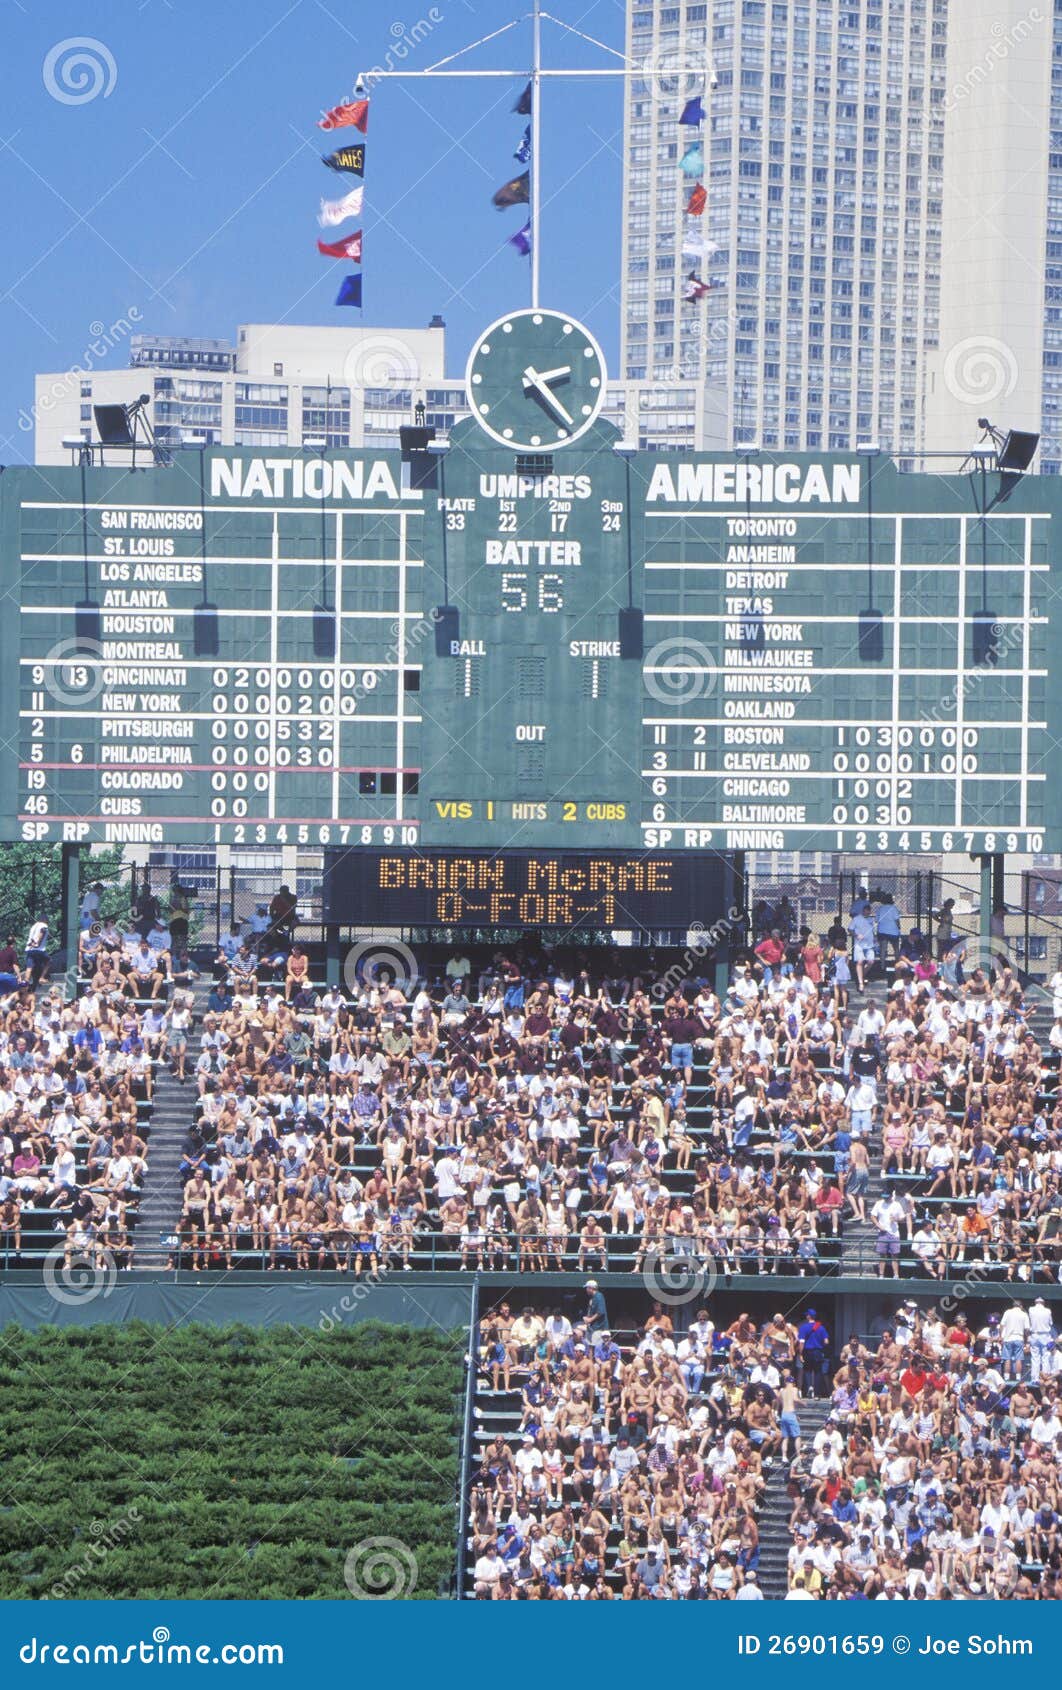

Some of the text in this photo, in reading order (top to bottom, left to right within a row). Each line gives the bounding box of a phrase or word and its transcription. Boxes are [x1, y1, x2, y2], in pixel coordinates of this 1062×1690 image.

[211, 458, 423, 499] NATIONAL
[480, 475, 592, 498] UMPIRES
[645, 464, 860, 503] AMERICAN
[437, 498, 623, 512] PLATE 1ST 2ND 3RD
[101, 512, 202, 530] SAN FRANCISCO
[446, 514, 621, 532] 33 22 17 24
[727, 519, 797, 537] TORONTO
[104, 538, 174, 556] ST. LOUIS
[486, 540, 581, 566] BATTER
[727, 545, 796, 563] ANAHEIM
[101, 564, 202, 582] LOS ANGELES
[725, 572, 789, 589] DETROIT
[103, 590, 168, 608] ATLANTA
[725, 598, 772, 615] TEXAS
[103, 617, 174, 634] HOUSTON
[725, 624, 803, 642] NEW YORK
[103, 642, 183, 660] MONTREAL
[450, 641, 486, 655] BALL
[569, 641, 621, 656] STRIKE
[724, 650, 813, 668] MILWAUKEE
[32, 666, 355, 688] 9 13 CINCINNATI 0 2 0 0 0 0 0
[465, 659, 471, 697] 1
[592, 660, 598, 698] 1
[724, 676, 811, 693] MINNESOTA
[32, 692, 312, 713] 11 NEW YORK 0 0 0 0 2
[724, 702, 795, 719] OAKLAND
[32, 719, 333, 740] 2 PITTSBURGH 0 0 0 5 3 2
[515, 725, 546, 741] OUT
[654, 726, 934, 746] 11 2 BOSTON 1 0 3 0 0
[31, 744, 333, 766] 5 6 PHILADELPHIA 0 0 0 0 3 0
[652, 752, 929, 772] 3 11 CLEVELAND 0 0 0 0 1
[27, 770, 269, 791] 19 COLORADO 0 0 0
[652, 778, 912, 798] 6 CHICAGO 1 0 0 2
[24, 796, 247, 817] 46 CUBS 0 0
[436, 803, 626, 821] VIS 1 HITS 2 CUBS
[653, 803, 911, 825] 6 BALTIMORE 0 0 3 0
[22, 822, 417, 845] SP RP INNING 1 2 3 4 5 6 7 8 9 10
[644, 830, 1043, 852] SP RP INNING 1 2 3 4 5 6 7 8 9 10
[379, 858, 673, 892] BRIAN McRAE
